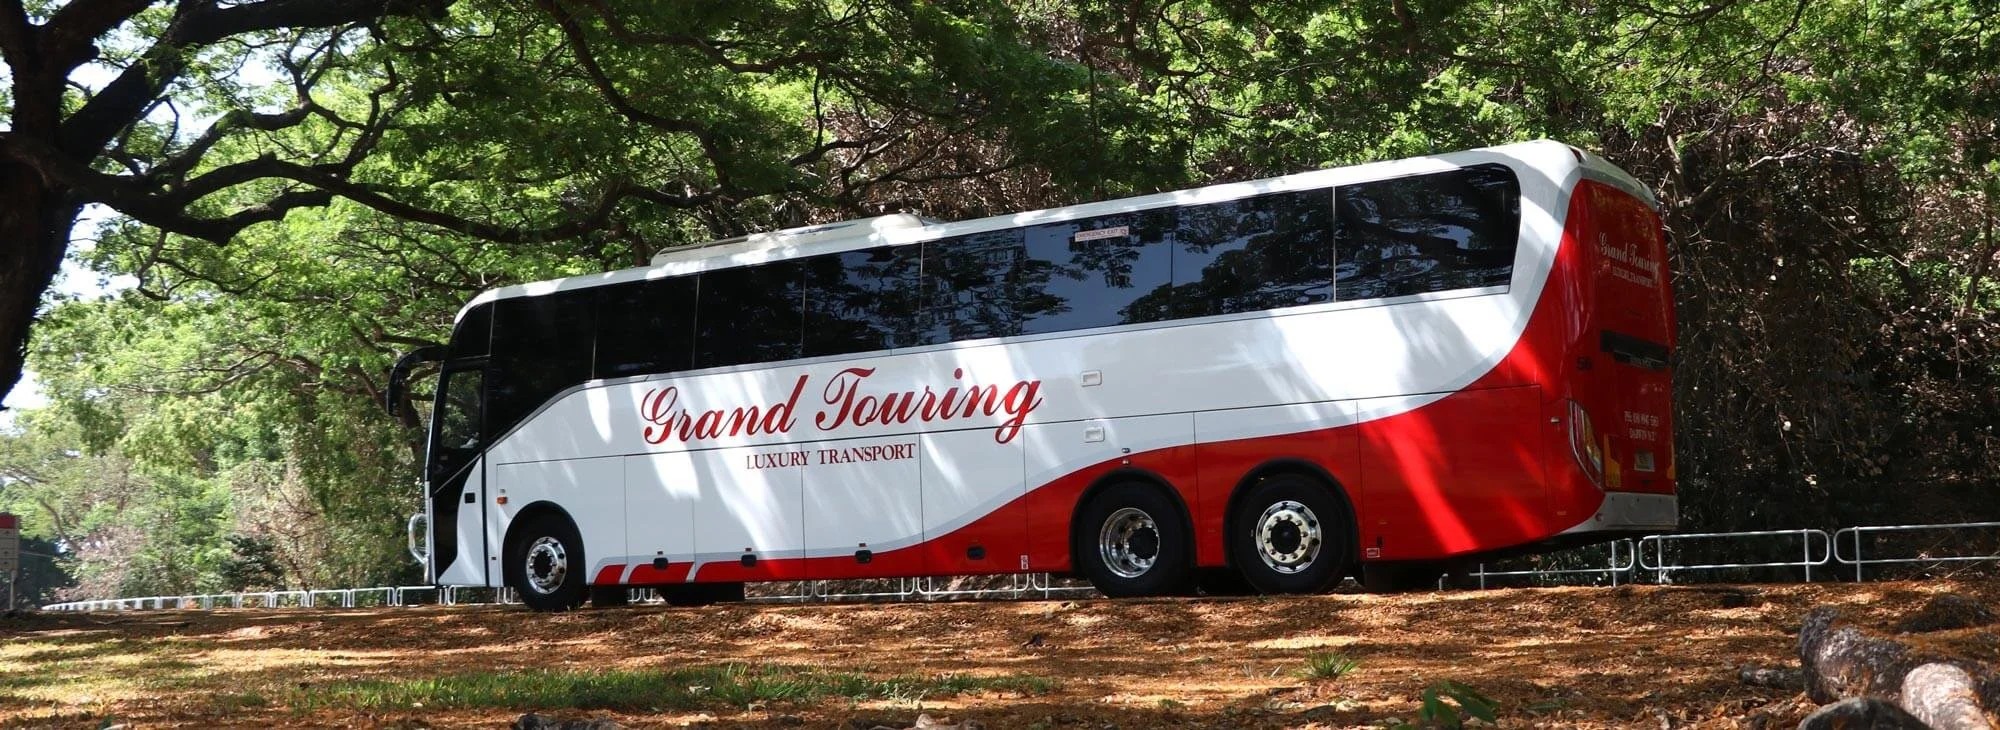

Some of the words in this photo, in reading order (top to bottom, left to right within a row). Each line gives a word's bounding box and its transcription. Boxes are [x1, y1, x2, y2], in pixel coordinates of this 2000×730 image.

[1598, 231, 1629, 264] Grand
[641, 374, 808, 446] Grand
[815, 367, 1043, 445] Touring
[746, 450, 811, 470] LUXURY
[816, 443, 917, 466] TRANSPORT
